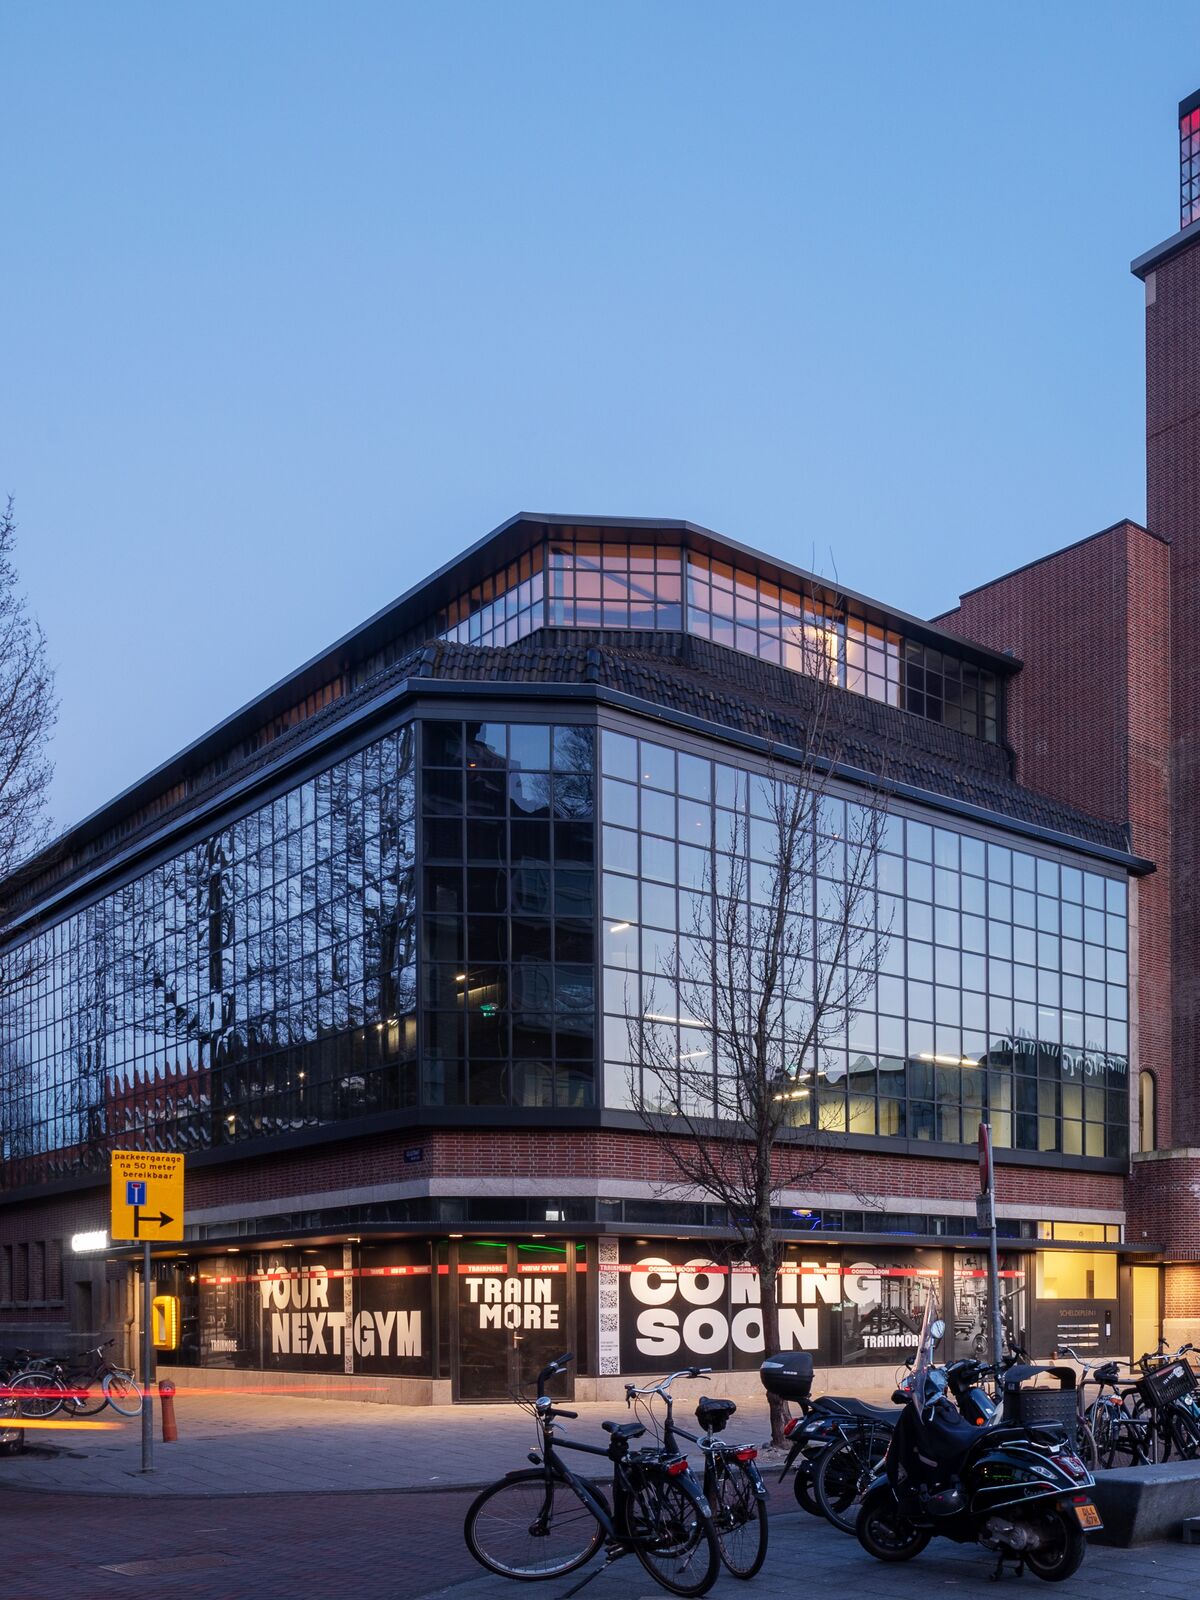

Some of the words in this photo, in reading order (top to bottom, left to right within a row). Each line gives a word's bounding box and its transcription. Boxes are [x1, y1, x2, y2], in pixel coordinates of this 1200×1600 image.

[115, 1154, 182, 1163] parkeergarage
[123, 1171, 173, 1179] bereikbaar
[257, 1266, 329, 1310] YOUR
[465, 1278, 552, 1303] TRAIN
[630, 1257, 881, 1306] COMING
[272, 1312, 346, 1355] NEXT
[354, 1310, 422, 1357] GYM
[480, 1304, 559, 1329] MORE
[636, 1307, 818, 1356] SOON
